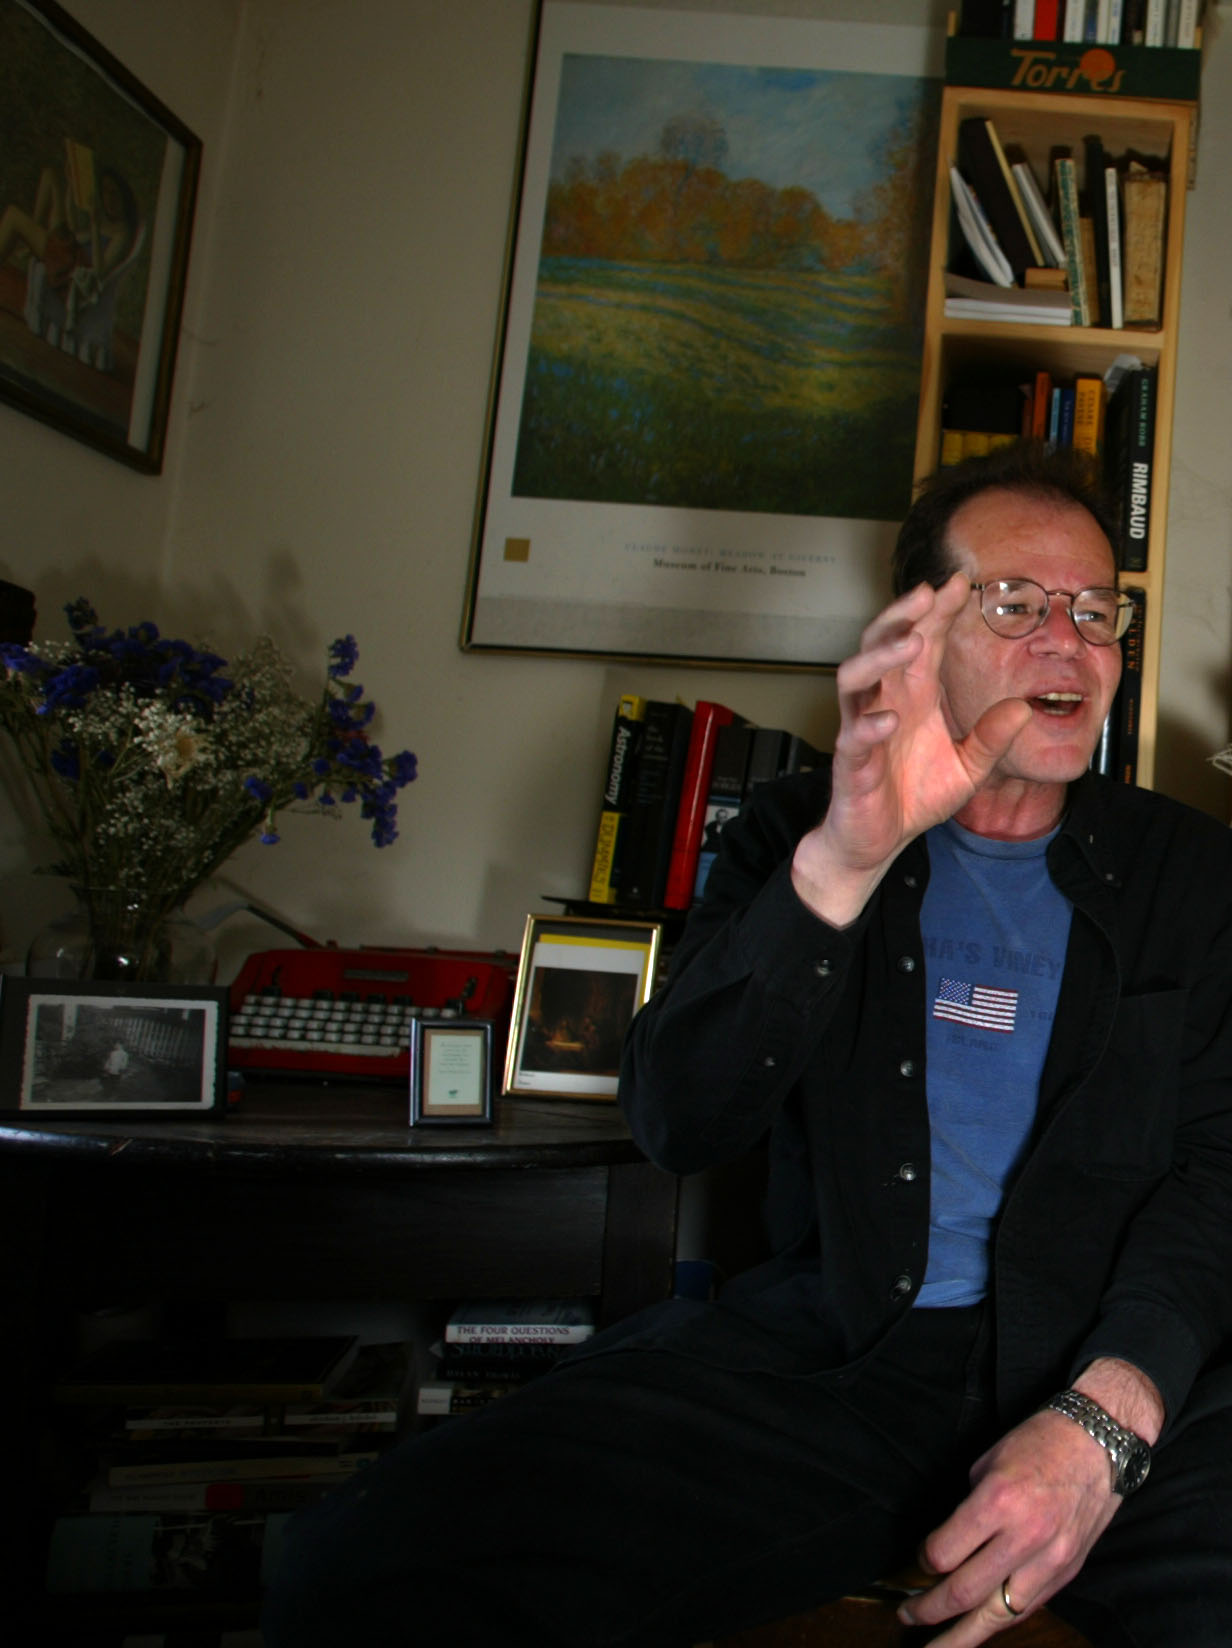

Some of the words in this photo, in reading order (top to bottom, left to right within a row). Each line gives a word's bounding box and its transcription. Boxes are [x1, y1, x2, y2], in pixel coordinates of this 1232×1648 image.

[1130, 462, 1150, 540] RIMBAUD
[653, 558, 697, 571] Museum
[700, 560, 711, 571] of
[714, 561, 736, 572] Fine
[770, 565, 806, 577] Boston
[604, 725, 631, 805] Astronomy
[457, 1326, 476, 1335] THE
[480, 1326, 508, 1335] FOUR
[510, 1326, 570, 1336] QUESTIONS
[469, 1336, 481, 1344] OF
[486, 1336, 555, 1344] MELANCHOLY
